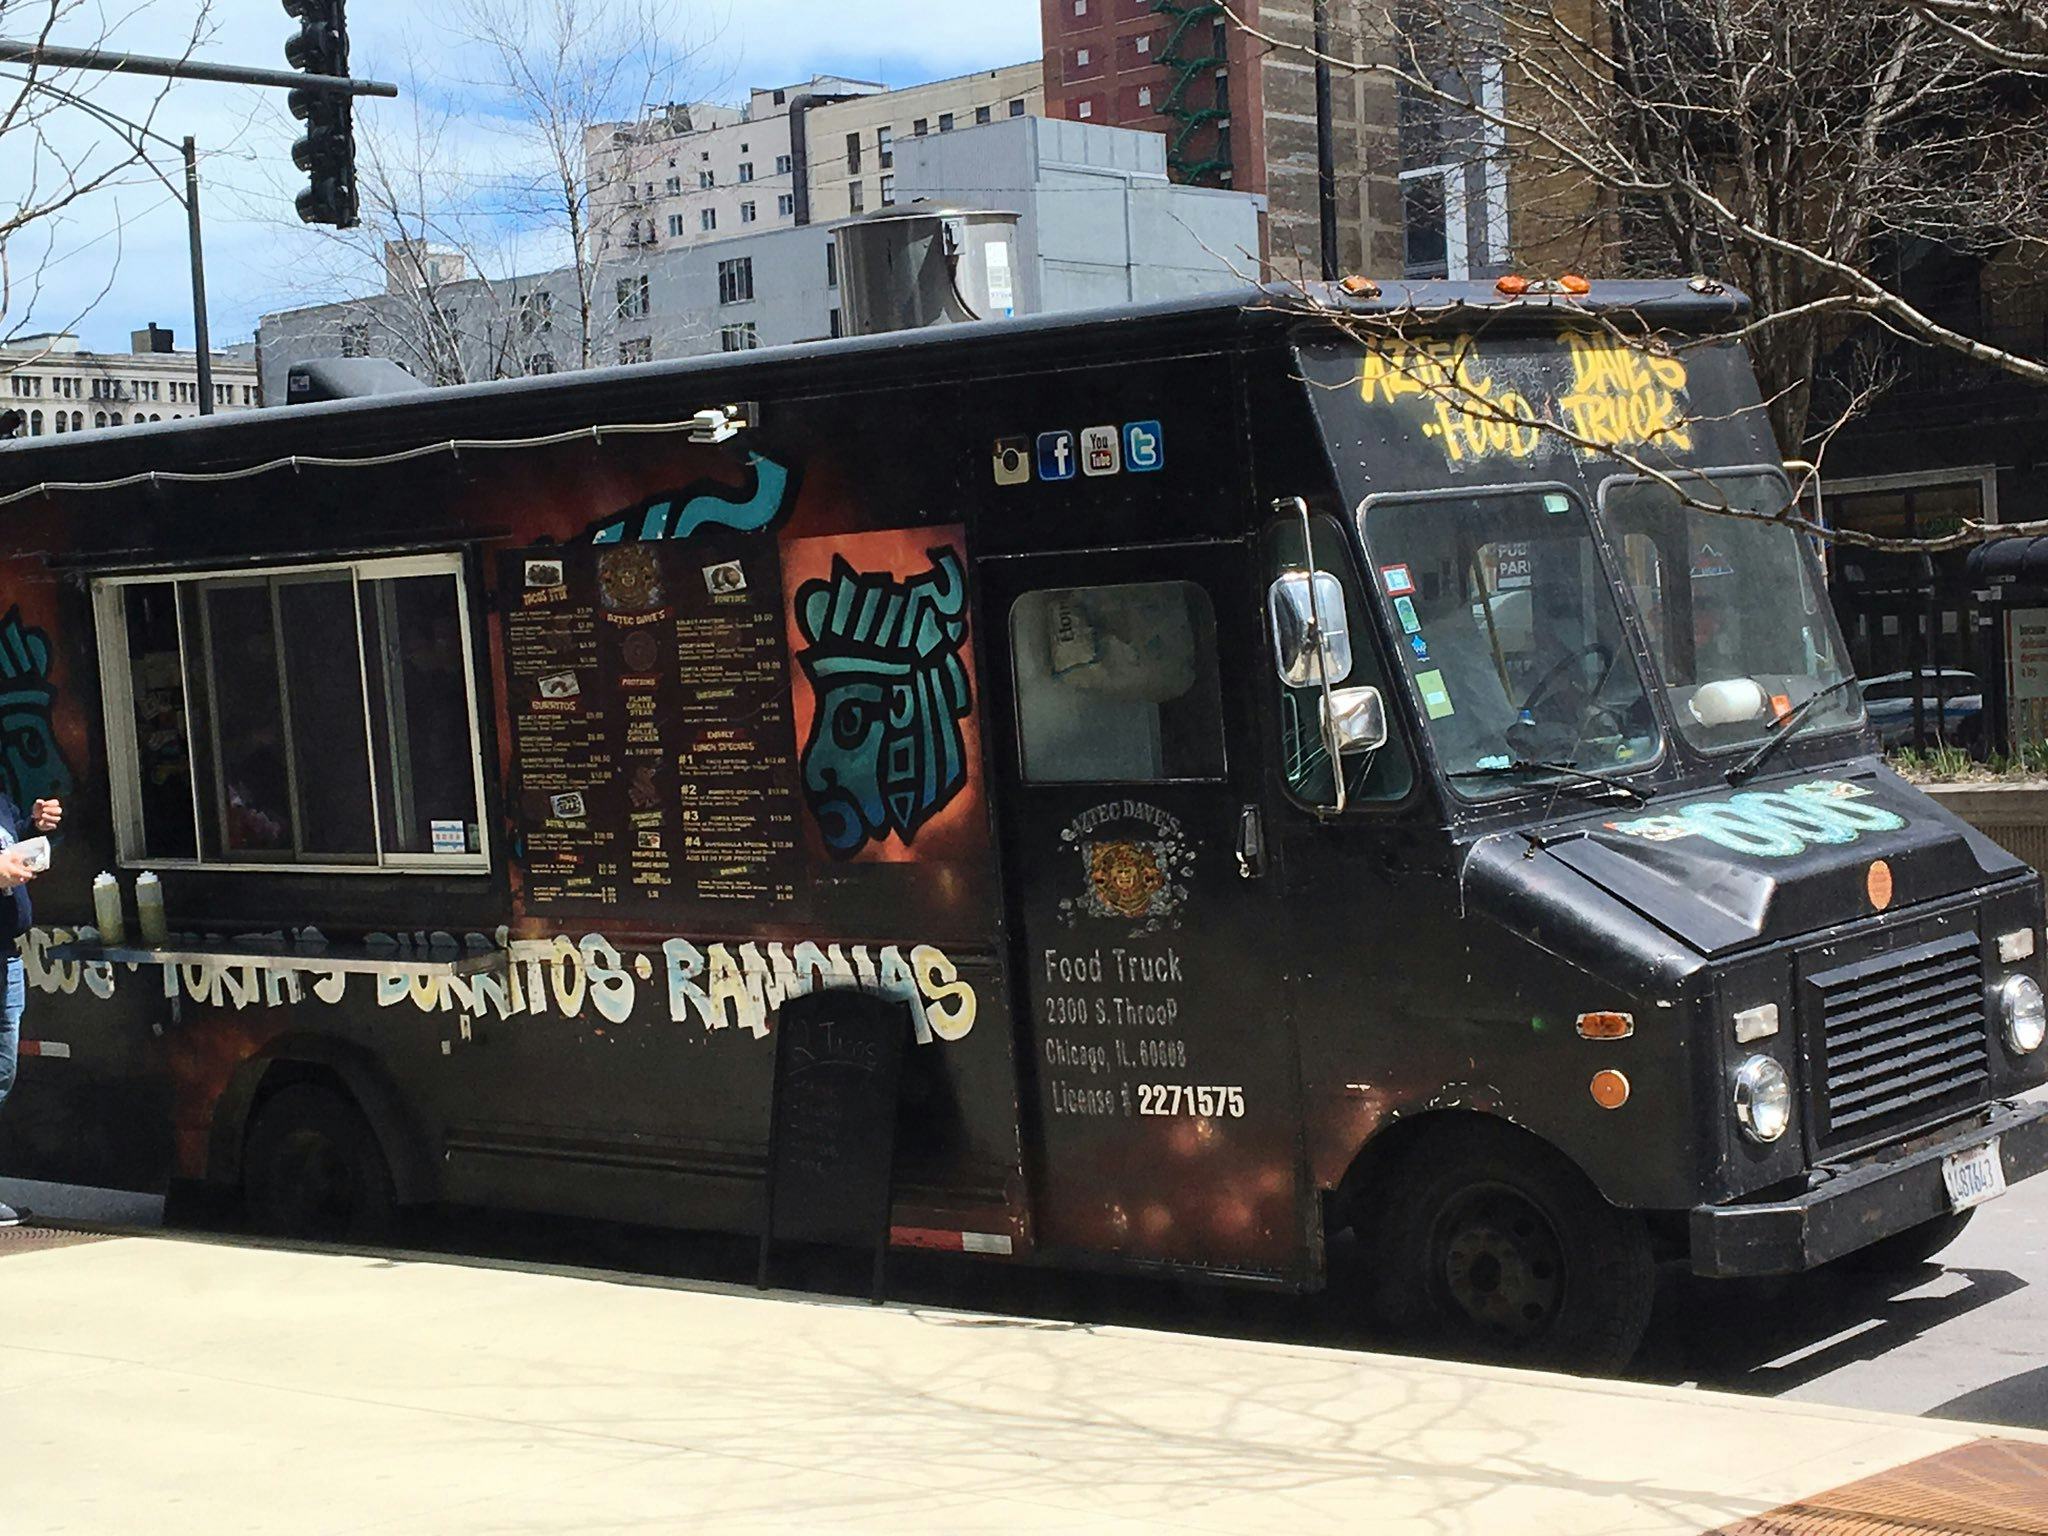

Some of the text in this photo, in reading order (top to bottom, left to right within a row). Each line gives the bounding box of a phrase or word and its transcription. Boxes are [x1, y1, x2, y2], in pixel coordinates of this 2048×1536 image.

[1558, 389, 1692, 457] TRUCK
[1090, 433, 1108, 449] You
[1499, 562, 1531, 577] PAR
[606, 612, 634, 625] AZTEC
[531, 700, 577, 711] BURRITOS
[678, 754, 693, 764] #1
[680, 784, 697, 795] #2
[683, 810, 699, 821] #3
[1071, 799, 1181, 837] AZTEC DAVE'S
[684, 836, 701, 847] #4
[1045, 948, 1183, 982] Food Truck
[1046, 997, 1088, 1024] 2300
[1045, 1038, 1111, 1074] Chicago,
[1052, 1080, 1115, 1116] License
[1138, 1084, 1245, 1118] 2271575
